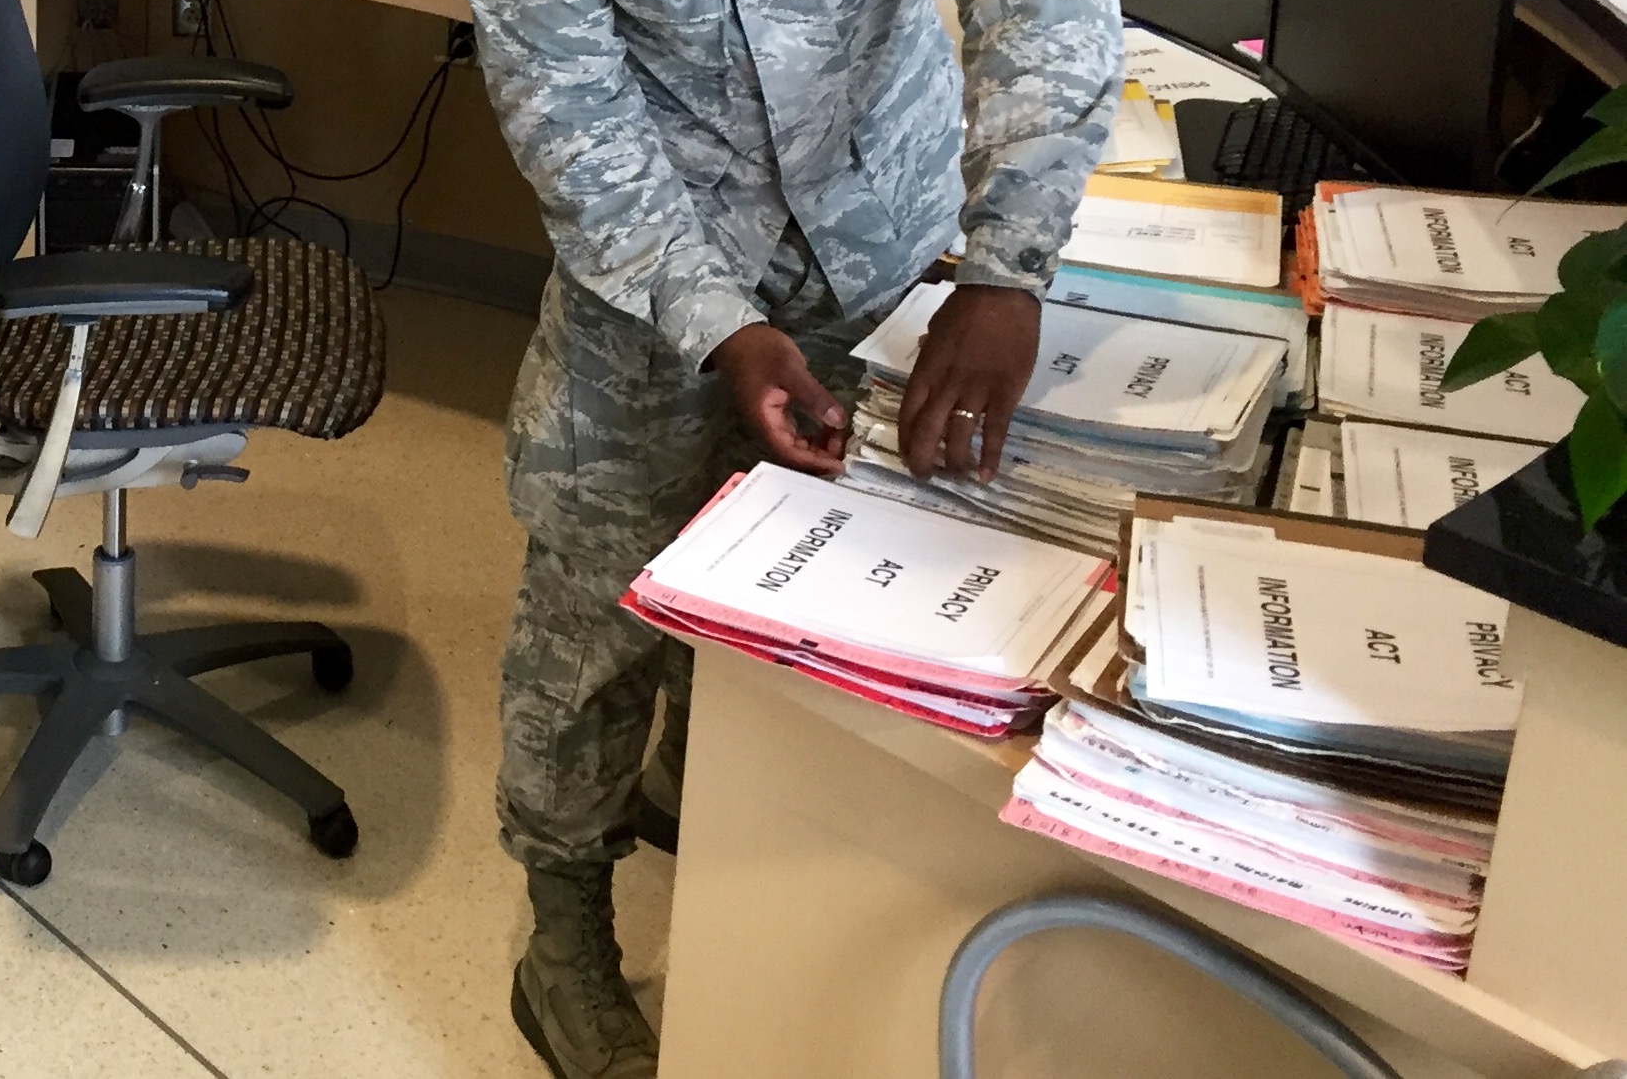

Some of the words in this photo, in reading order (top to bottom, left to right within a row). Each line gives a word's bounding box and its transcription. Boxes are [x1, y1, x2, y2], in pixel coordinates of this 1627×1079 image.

[1423, 207, 1464, 275] INFORMATION
[1507, 236, 1537, 258] ACT
[1049, 351, 1082, 376] ACT
[1123, 355, 1171, 399] PRIVACY
[1419, 332, 1446, 410] INFORMATION
[1504, 370, 1532, 397] ACT
[755, 508, 853, 594] INFORMATION
[864, 558, 905, 589] ACT
[934, 565, 1002, 623] PRIVACY
[1257, 576, 1303, 691] INFORMATION
[1364, 627, 1402, 665] ACT
[1465, 621, 1514, 690] PRIVACY
